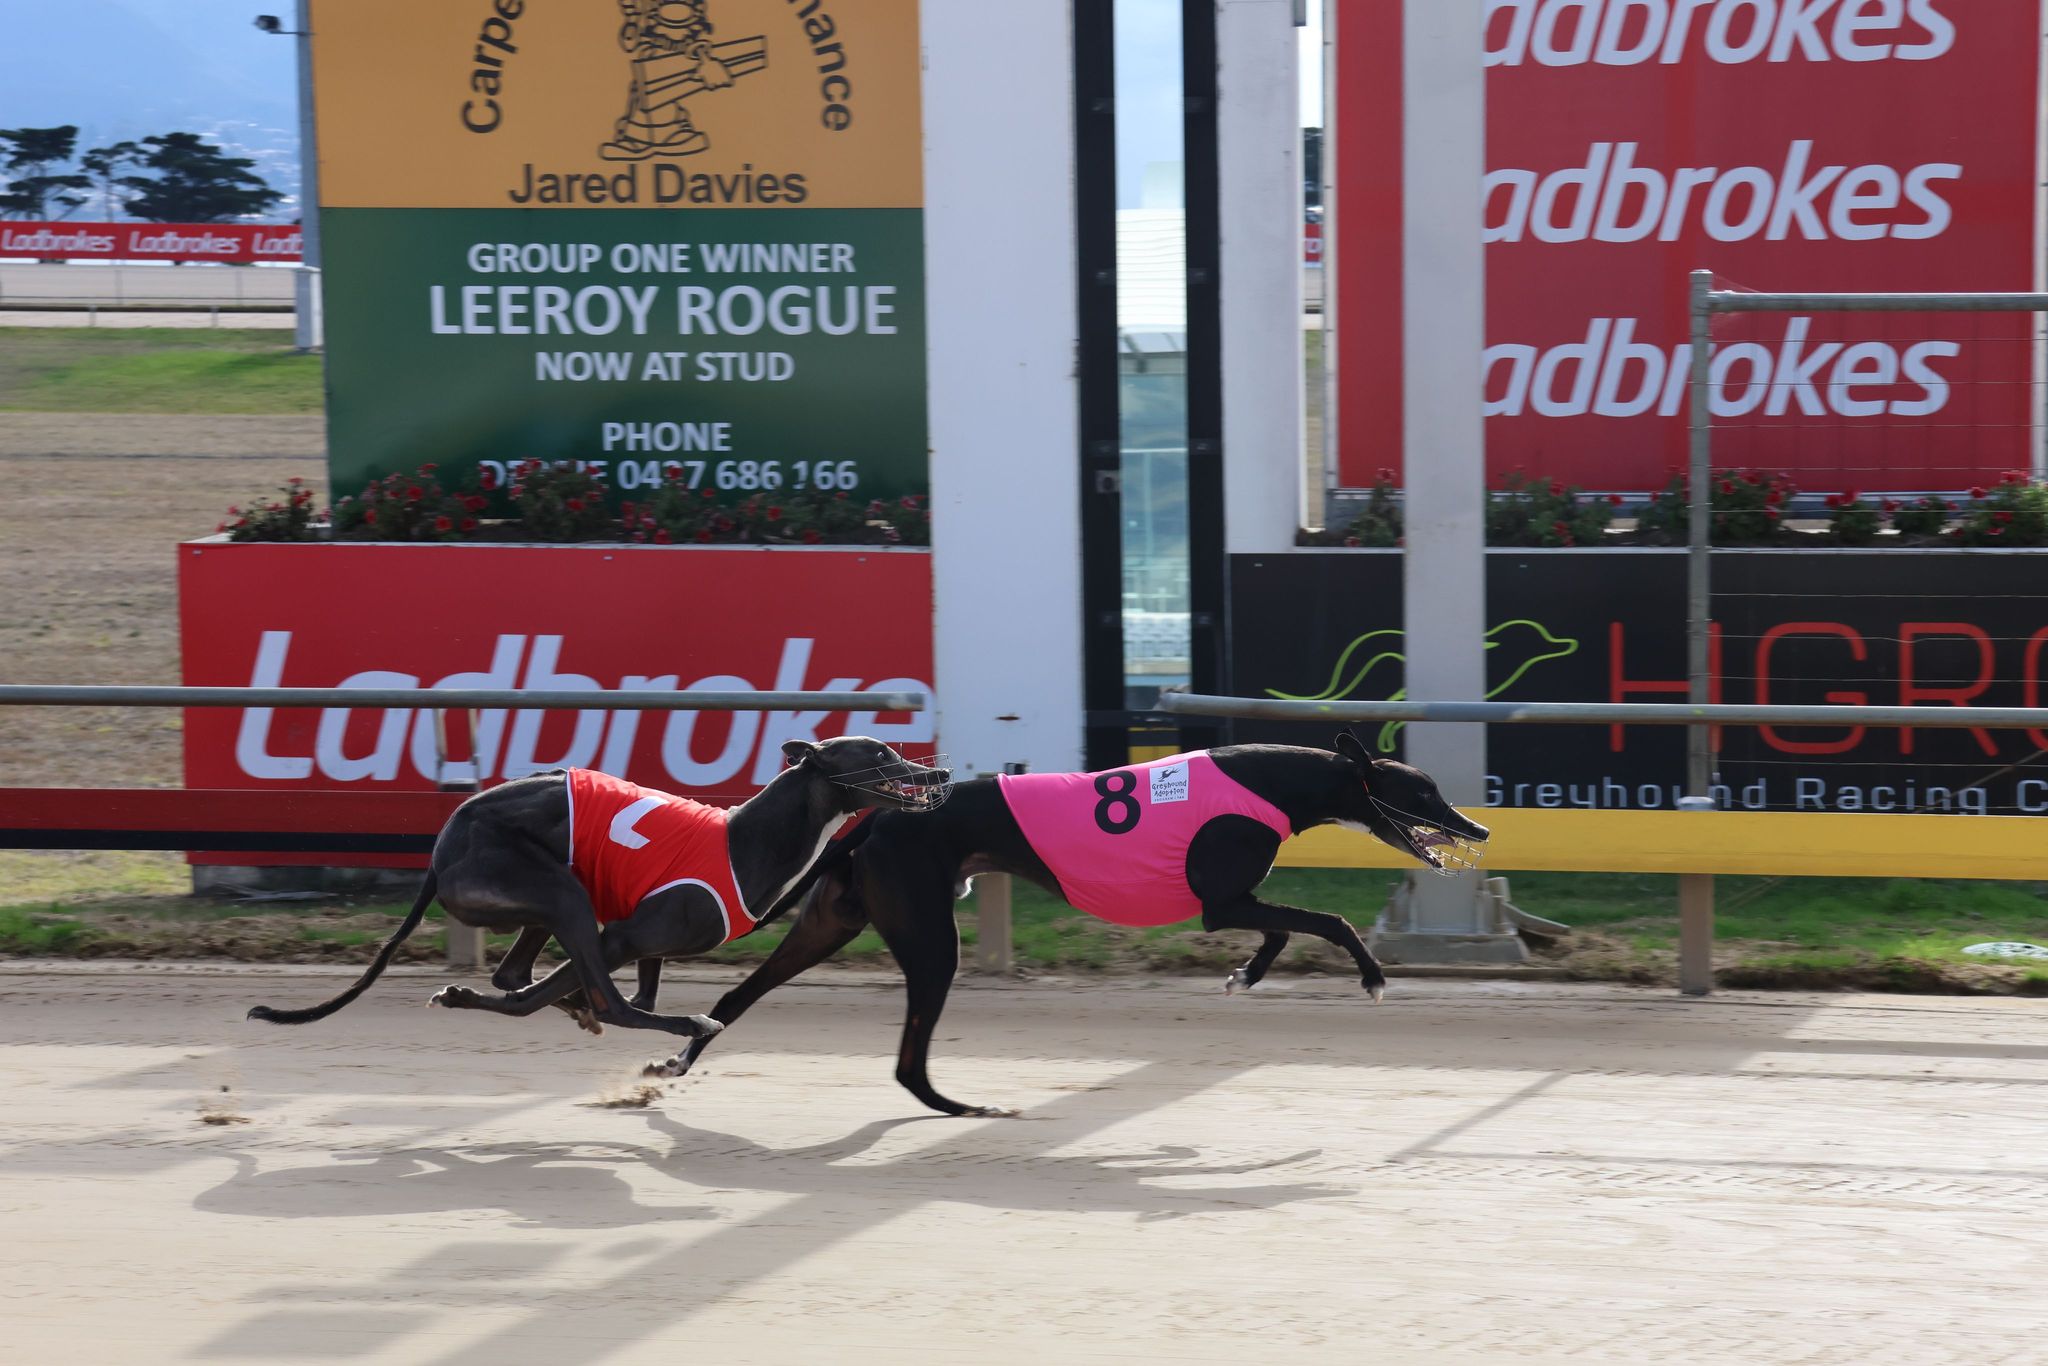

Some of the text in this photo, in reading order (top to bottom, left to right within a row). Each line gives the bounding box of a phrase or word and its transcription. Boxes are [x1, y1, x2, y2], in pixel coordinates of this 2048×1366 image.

[508, 162, 808, 204] Jared Davies
[1, 229, 116, 252] Ladbrokes
[128, 231, 242, 254] Ladbrokes
[468, 243, 856, 273] GROUP ONE WINNER
[430, 285, 898, 336] LEEROY ROGUE
[535, 351, 795, 382] NOW AT STUD
[602, 421, 732, 452] PHONE
[715, 460, 782, 490] 686
[792, 460, 859, 490] 166
[1152, 780, 1187, 790] Greyhound
[1154, 788, 1185, 797] Adoption
[1796, 778, 1987, 815] Racing
[1094, 770, 1141, 835] 8
